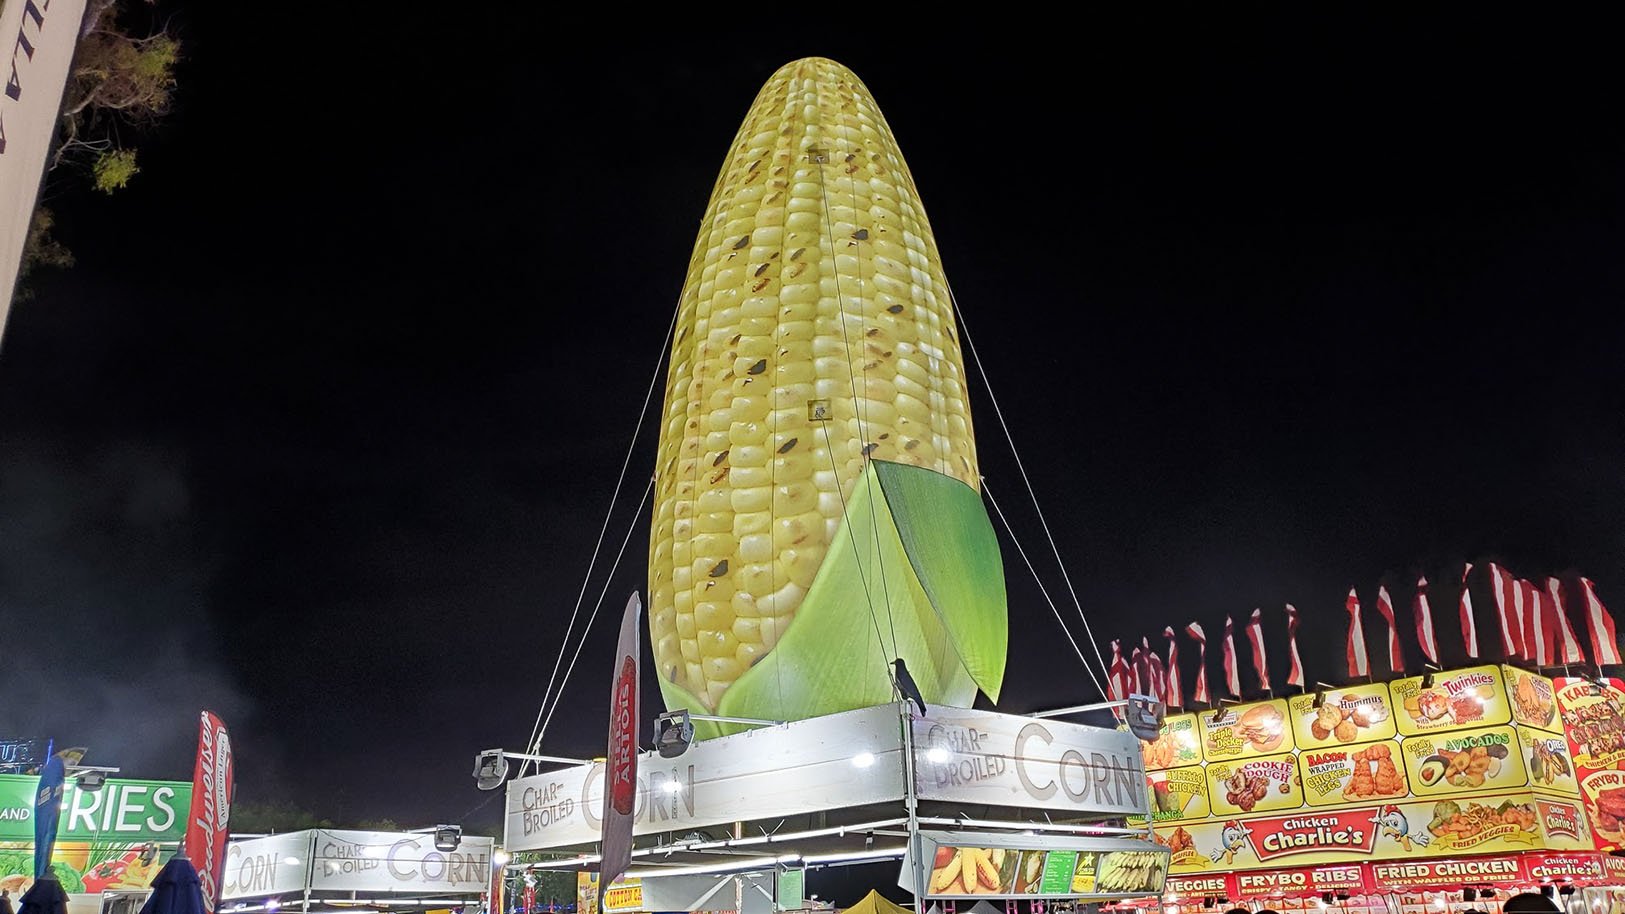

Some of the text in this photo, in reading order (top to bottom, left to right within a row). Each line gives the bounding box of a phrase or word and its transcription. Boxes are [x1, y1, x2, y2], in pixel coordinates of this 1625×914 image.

[5, 0, 50, 101] LLA
[1442, 673, 1493, 696] Twinkies
[1340, 696, 1383, 710] Hummus
[1563, 686, 1620, 703] KABBS
[620, 684, 630, 783] ARTOIS
[1208, 727, 1232, 741] Triple
[1445, 733, 1510, 751] AVOCADOS
[1216, 737, 1244, 748] Decker
[1015, 723, 1139, 809] CORN
[1244, 761, 1293, 774] COOKIE
[1306, 752, 1347, 767] BACON
[1166, 770, 1205, 784] BUFFALO
[1246, 769, 1289, 783] DOUGH
[1308, 762, 1345, 775] WRAPPED
[1306, 768, 1351, 788] CHICKEN
[522, 782, 564, 811] CHAR-
[1167, 782, 1207, 796] CHICKEN
[1315, 780, 1342, 797] LEGS
[0, 808, 30, 820] AND
[197, 711, 216, 913] Budweiser
[523, 798, 574, 837] BROILED
[1283, 816, 1338, 830] Chicken
[1263, 826, 1363, 853] Charlie's
[1452, 826, 1515, 848] FRIED VEGGIES
[387, 839, 486, 883] CORN
[1377, 860, 1519, 879] FRIED CHICKEN
[1544, 857, 1579, 865] Chicken
[224, 845, 279, 896] CORN
[1240, 870, 1360, 887] FRYBQ RIBS
[1532, 864, 1592, 877] Charlie's
[1166, 880, 1226, 892] VEGGIES
[1315, 882, 1361, 890] DELICIOUS
